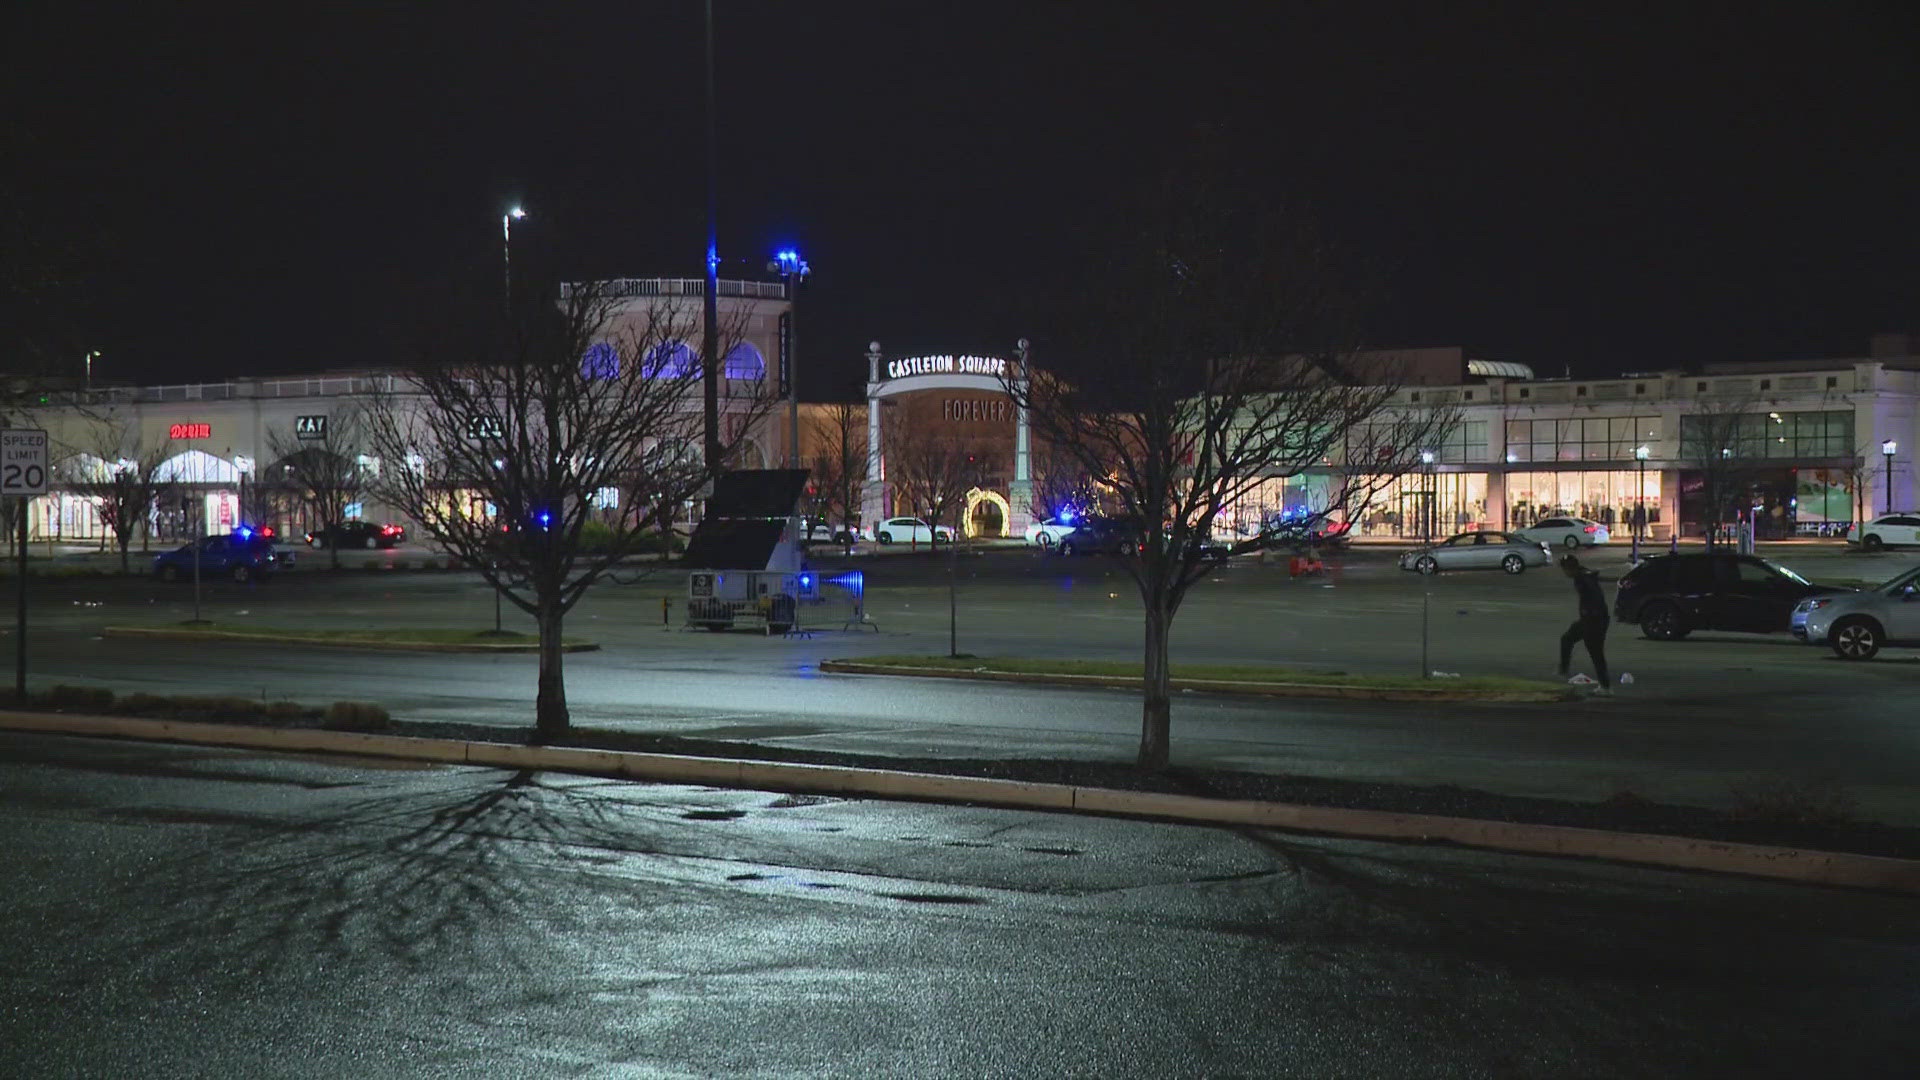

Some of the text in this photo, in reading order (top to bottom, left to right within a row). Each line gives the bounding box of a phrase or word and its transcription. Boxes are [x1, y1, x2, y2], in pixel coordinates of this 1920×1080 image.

[888, 355, 1006, 378] CASTLETON SQUARE
[944, 400, 1005, 421] FOREVER
[297, 417, 323, 432] KAY
[3, 435, 44, 446] SPEED
[7, 450, 38, 460] LIMIT
[4, 464, 44, 488] 20
